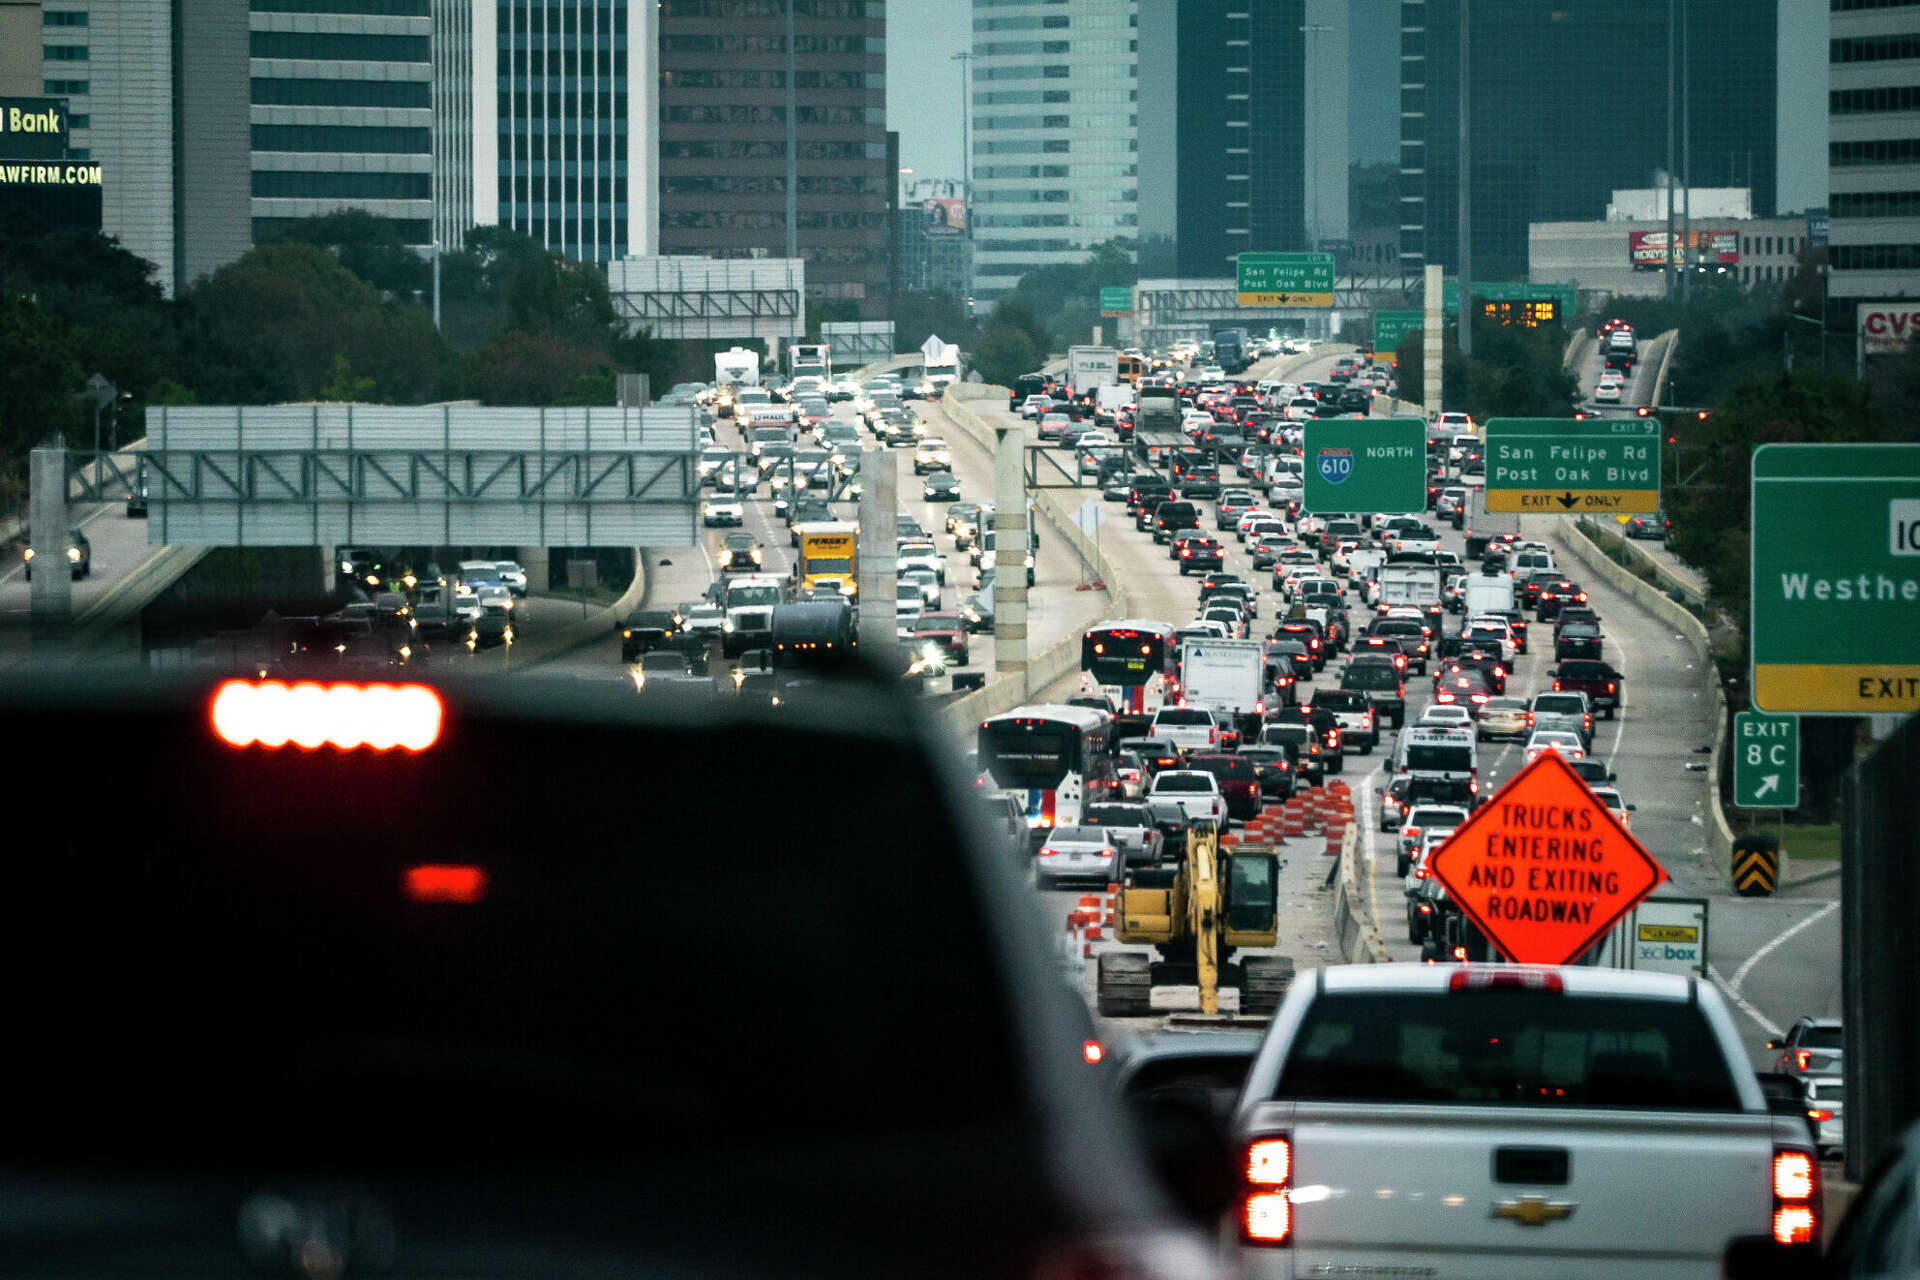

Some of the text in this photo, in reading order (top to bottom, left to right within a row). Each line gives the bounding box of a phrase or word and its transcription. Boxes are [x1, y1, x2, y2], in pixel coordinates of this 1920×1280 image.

[9, 107, 60, 133] Bank
[0, 166, 102, 184] AWFIRM.COM
[1245, 267, 1328, 277] San Felipe Rd
[1243, 280, 1329, 288] Post Oak Blvd
[754, 413, 786, 421] U-HAUL
[1611, 421, 1654, 433] EXIT 9
[1366, 447, 1414, 458] NORTH
[1499, 445, 1647, 462] San Felipe Rd
[1321, 458, 1350, 474] 610
[1496, 467, 1649, 481] Post Oak Blvd
[1521, 495, 1622, 506] EXIT ONLY
[1781, 573, 1919, 601] Westhe
[1858, 677, 1920, 699] EXIT
[1743, 722, 1790, 737] EXIT
[1502, 804, 1593, 832] TRUCKS
[1486, 834, 1604, 864] ENTERING
[1468, 865, 1620, 895] AND EXITING
[1487, 896, 1596, 925] ROADWAY
